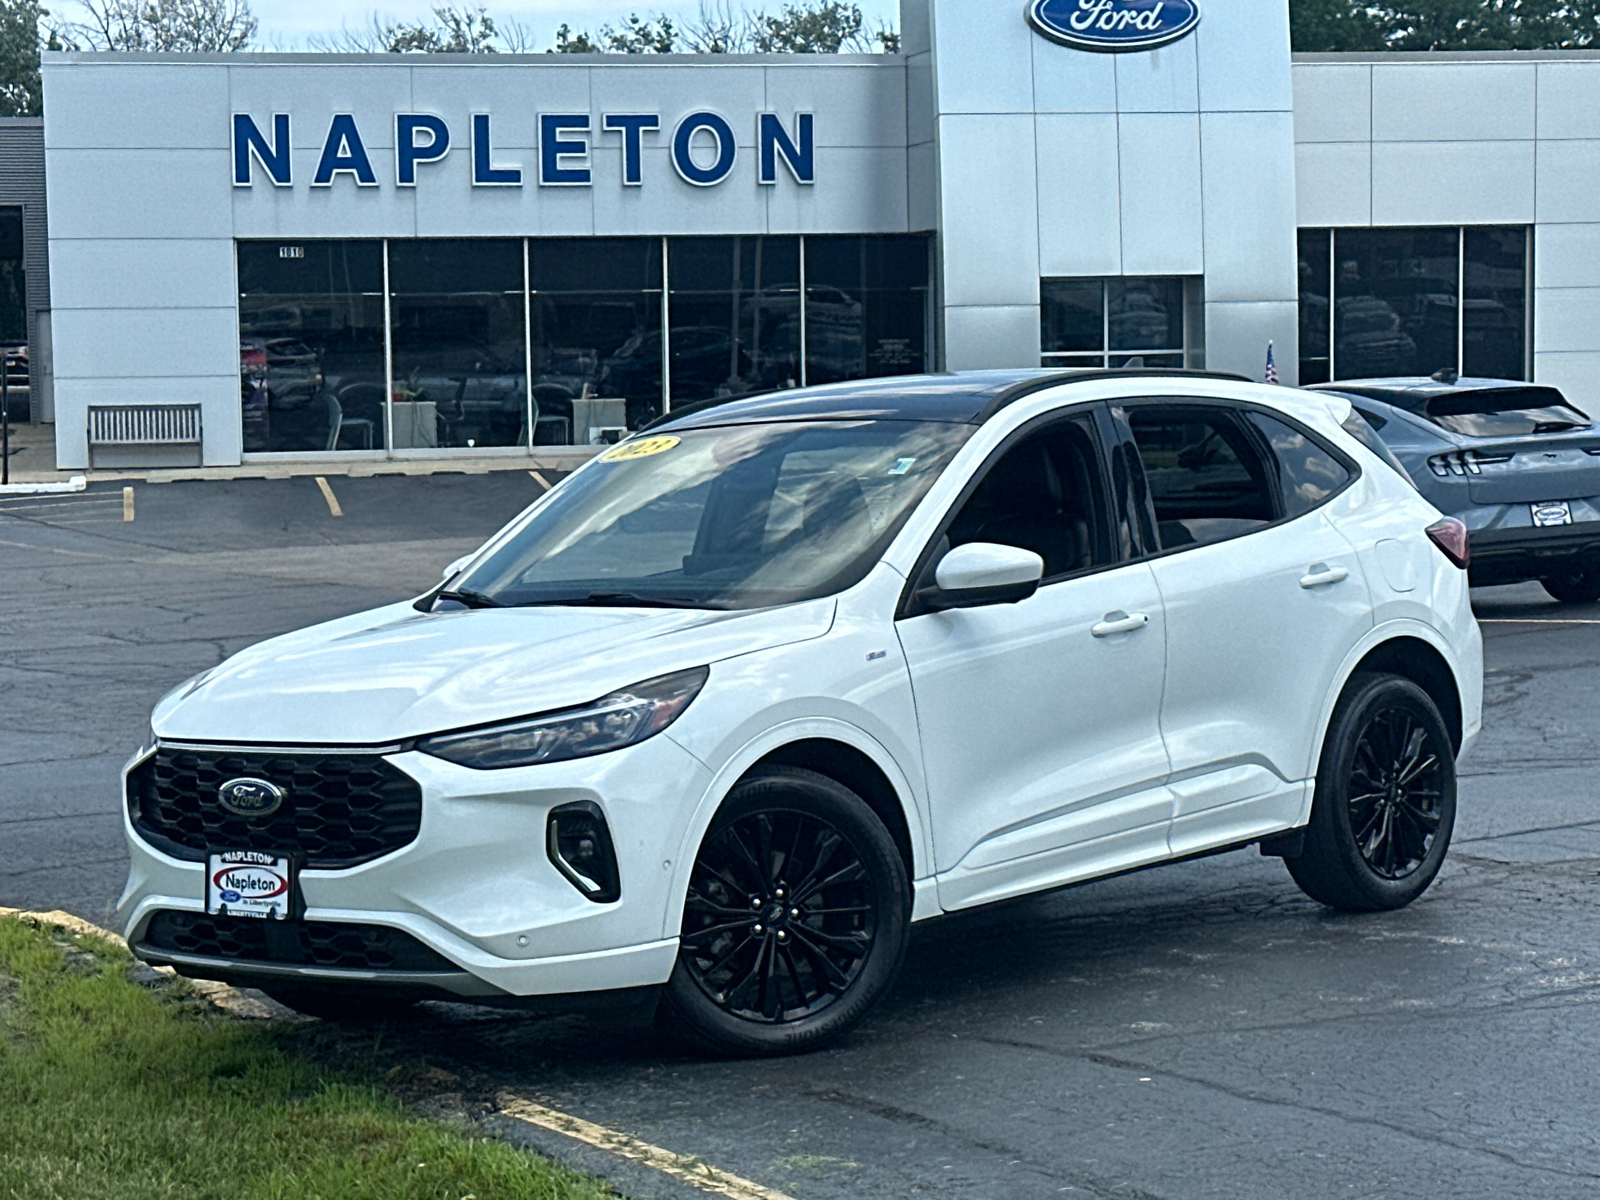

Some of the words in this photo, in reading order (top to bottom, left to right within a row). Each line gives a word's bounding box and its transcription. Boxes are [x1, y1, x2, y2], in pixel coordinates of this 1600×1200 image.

[1069, 0, 1163, 30] Ford
[231, 111, 815, 187] NAPLETON
[231, 785, 265, 807] Ford
[223, 851, 275, 865] NAPLETON
[225, 872, 276, 892] Napleton
